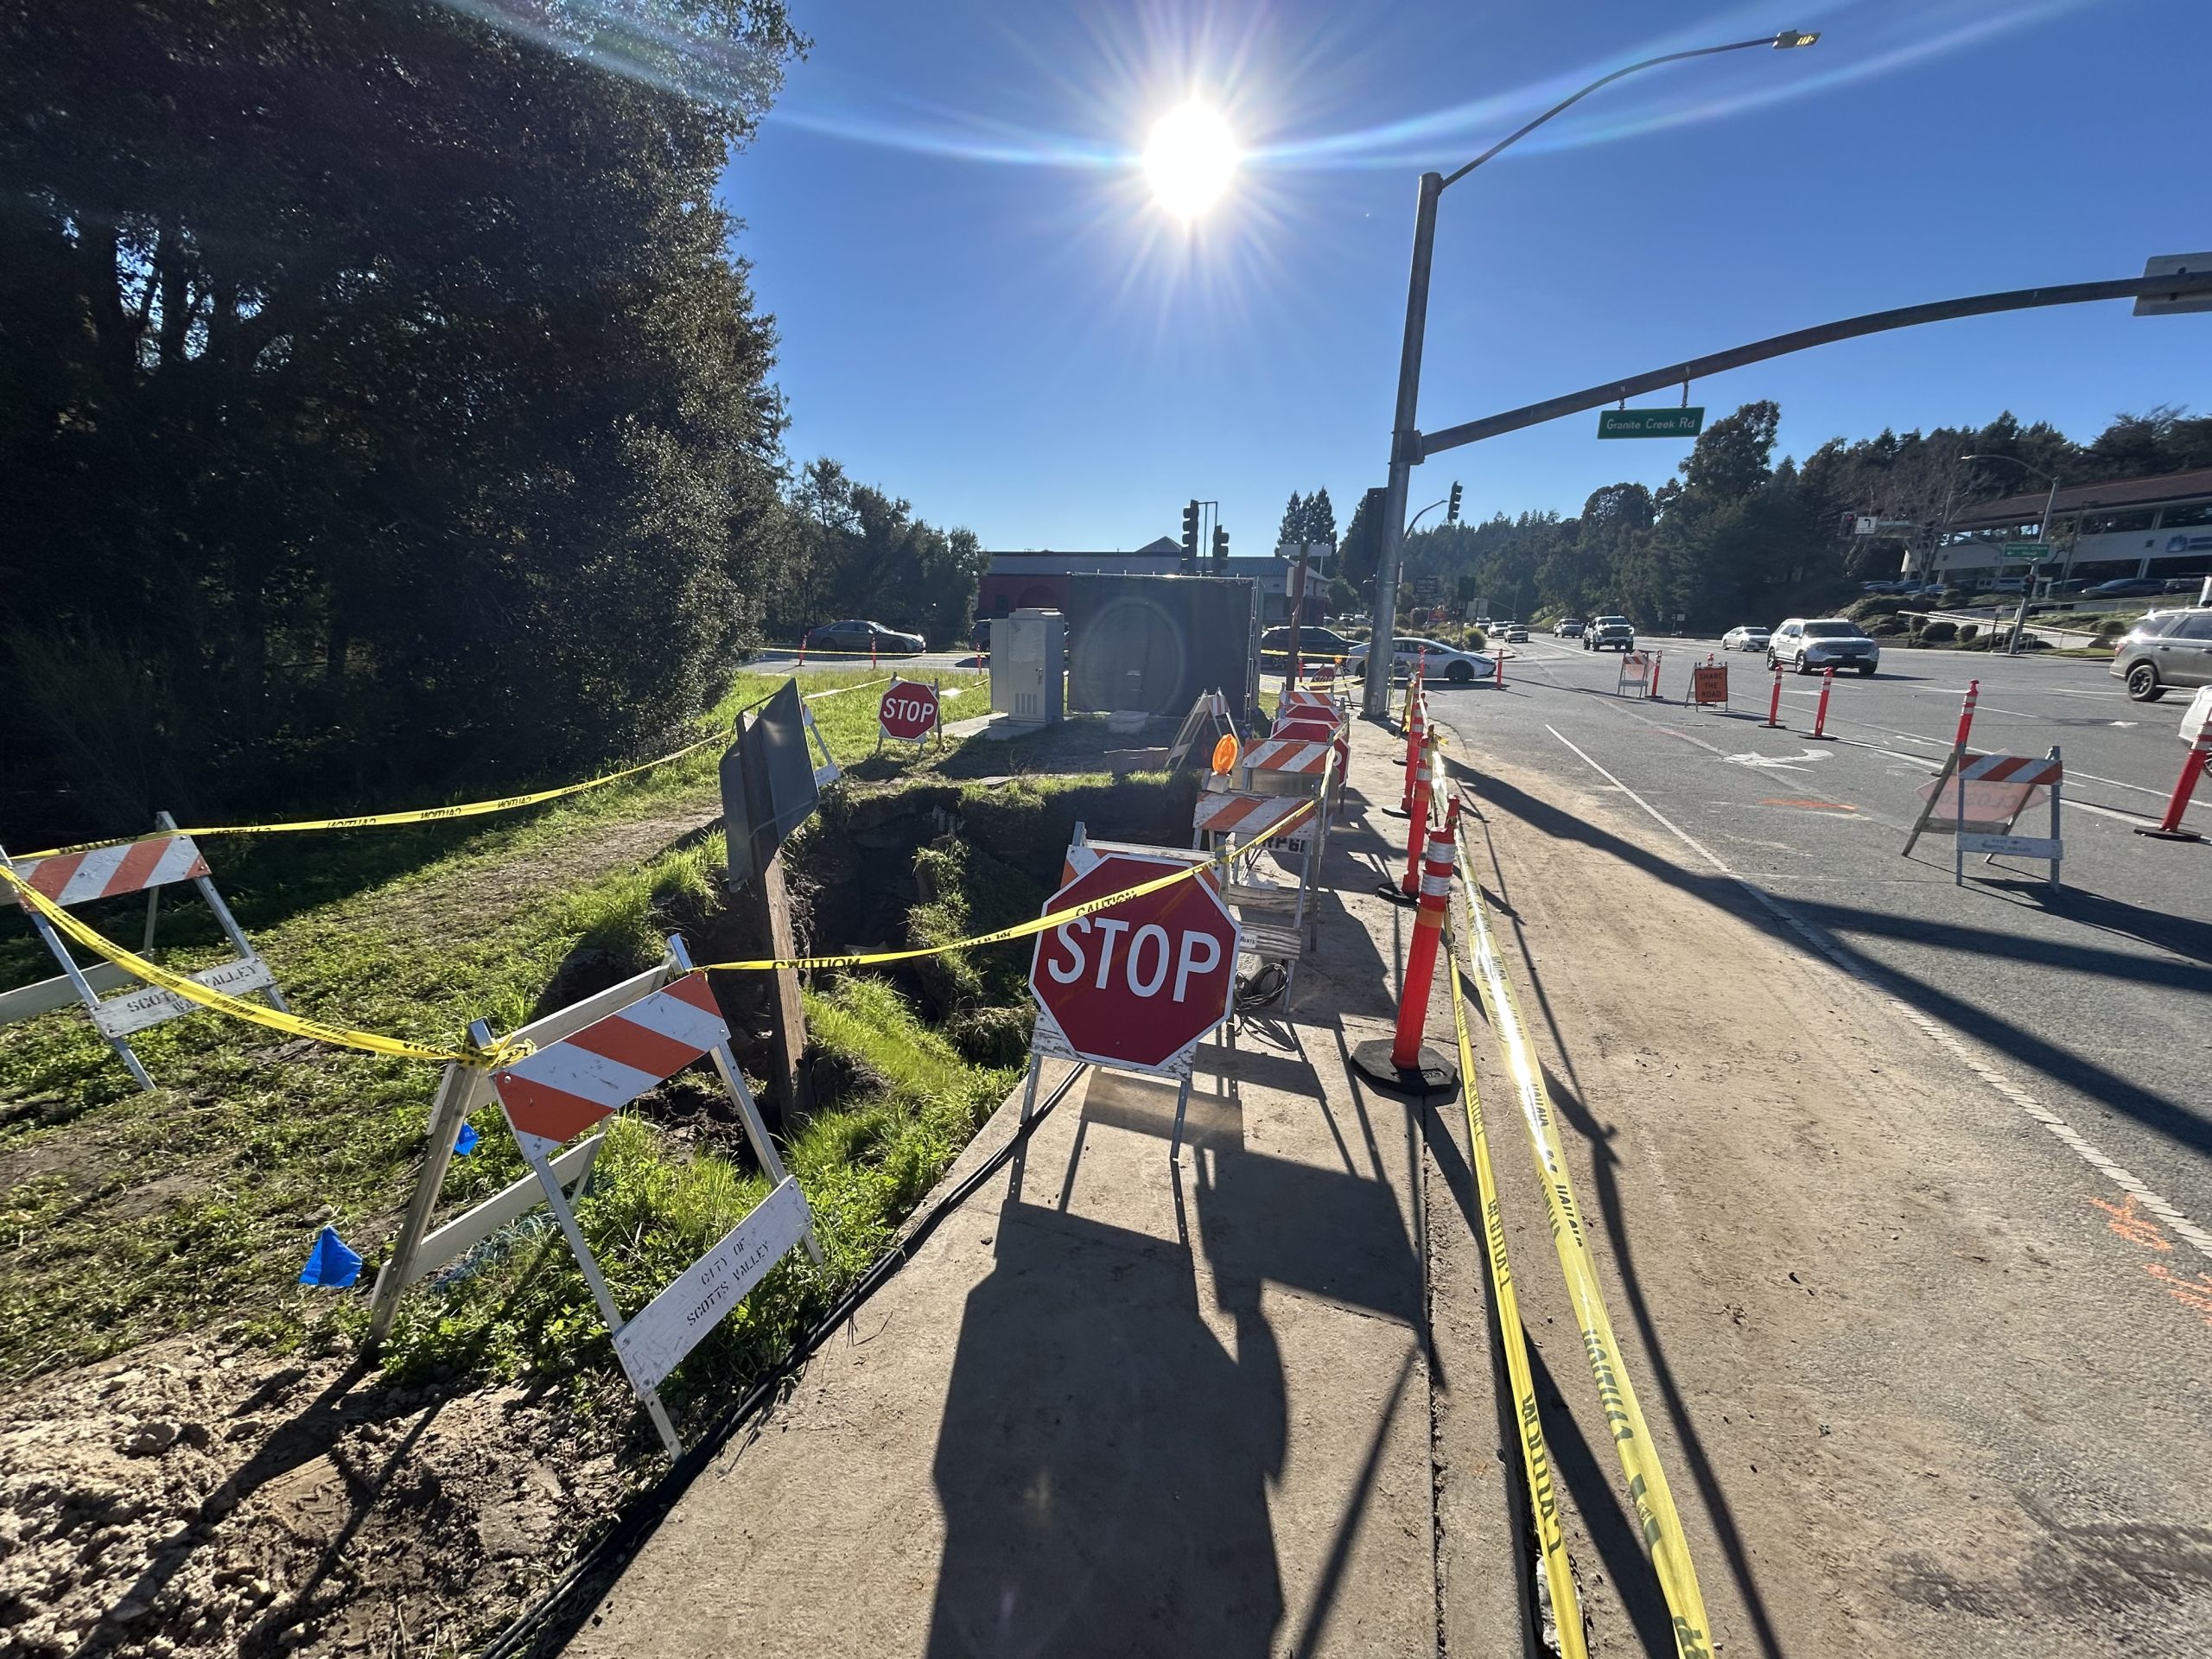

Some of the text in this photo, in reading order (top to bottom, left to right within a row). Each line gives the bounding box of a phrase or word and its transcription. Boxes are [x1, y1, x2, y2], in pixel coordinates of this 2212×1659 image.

[1606, 416, 1694, 430] Granite Creek Rd
[883, 697, 934, 723] STOP
[1047, 915, 1222, 1003] STOP
[686, 1240, 771, 1326] SCOTTS VALLEY
[701, 1237, 747, 1286] CITY OF
